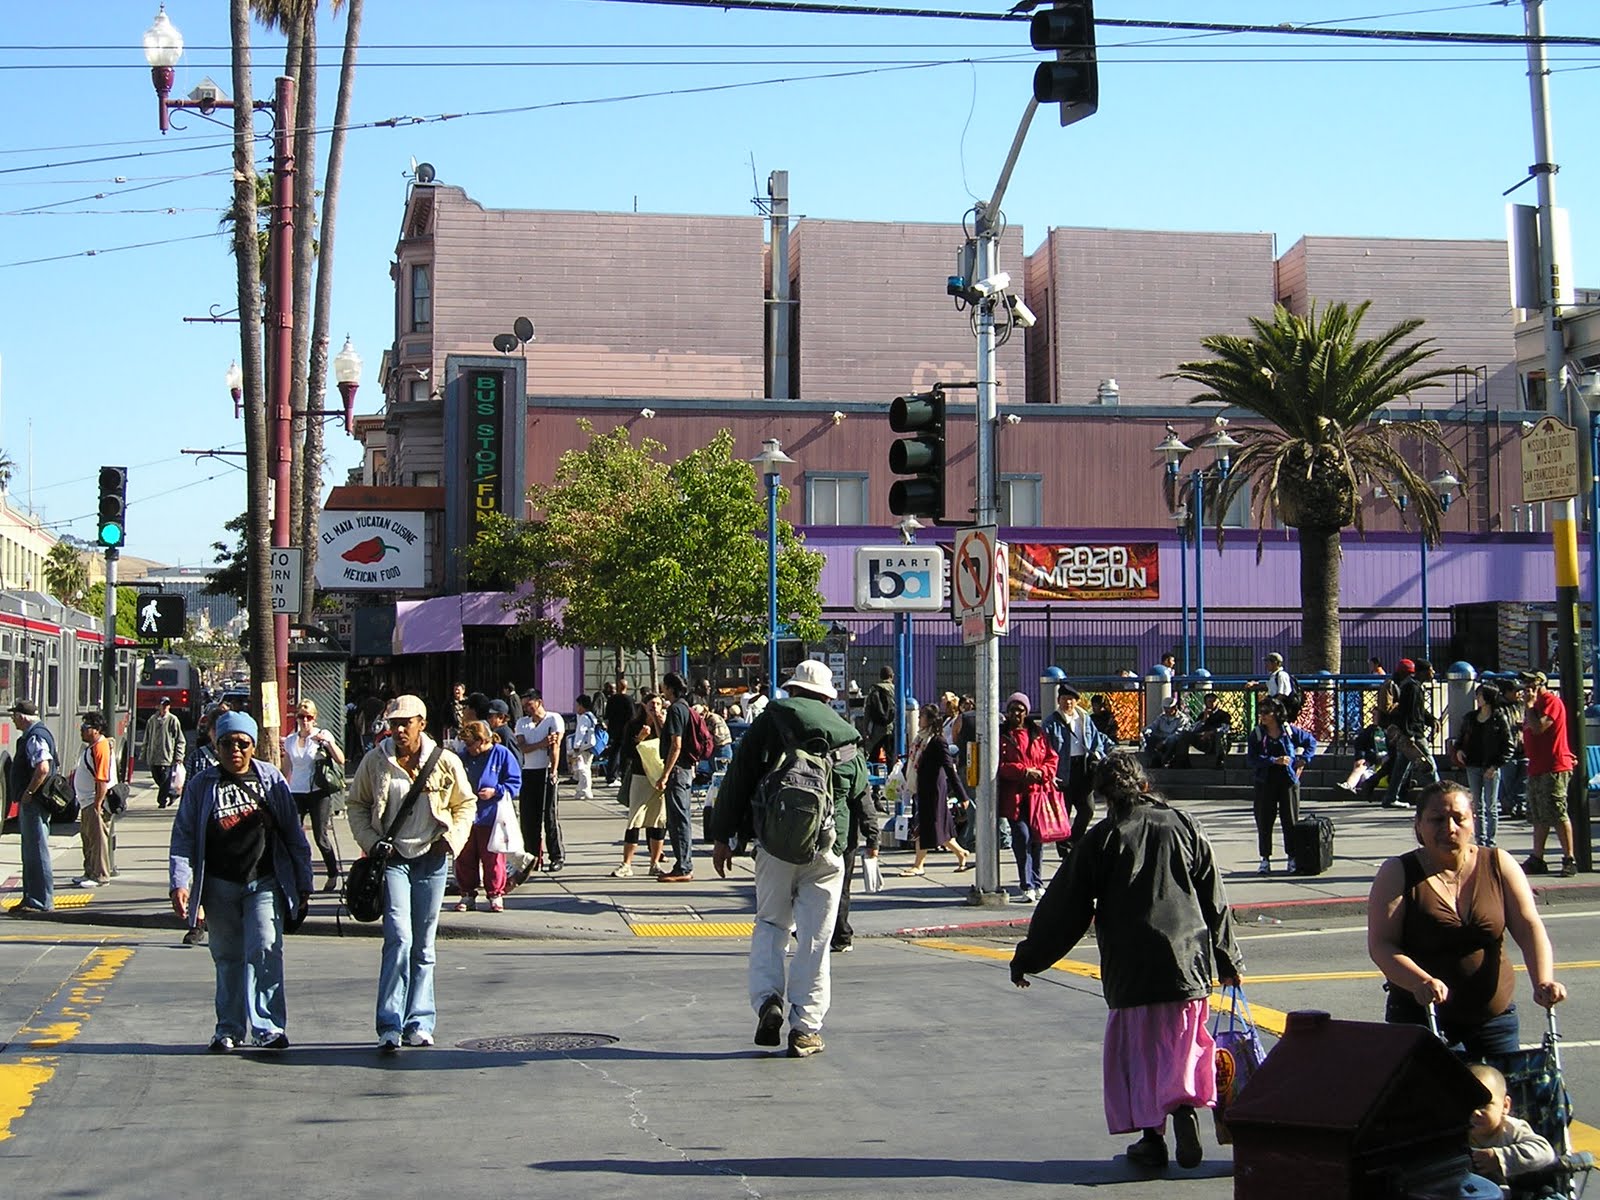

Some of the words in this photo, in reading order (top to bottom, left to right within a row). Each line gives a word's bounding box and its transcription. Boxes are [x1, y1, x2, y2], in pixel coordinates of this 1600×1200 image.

[476, 377, 496, 416] BUS
[1536, 449, 1562, 465] MISSION
[321, 532, 335, 545] EL
[333, 519, 354, 537] MAYA
[356, 516, 391, 530] YUCATAN
[391, 521, 418, 546] CUSINE
[885, 558, 931, 568] BART
[1056, 546, 1128, 567] 2020
[343, 567, 378, 583] MEXICAN
[380, 565, 401, 581] FOOD
[1032, 565, 1147, 589] MISSION
